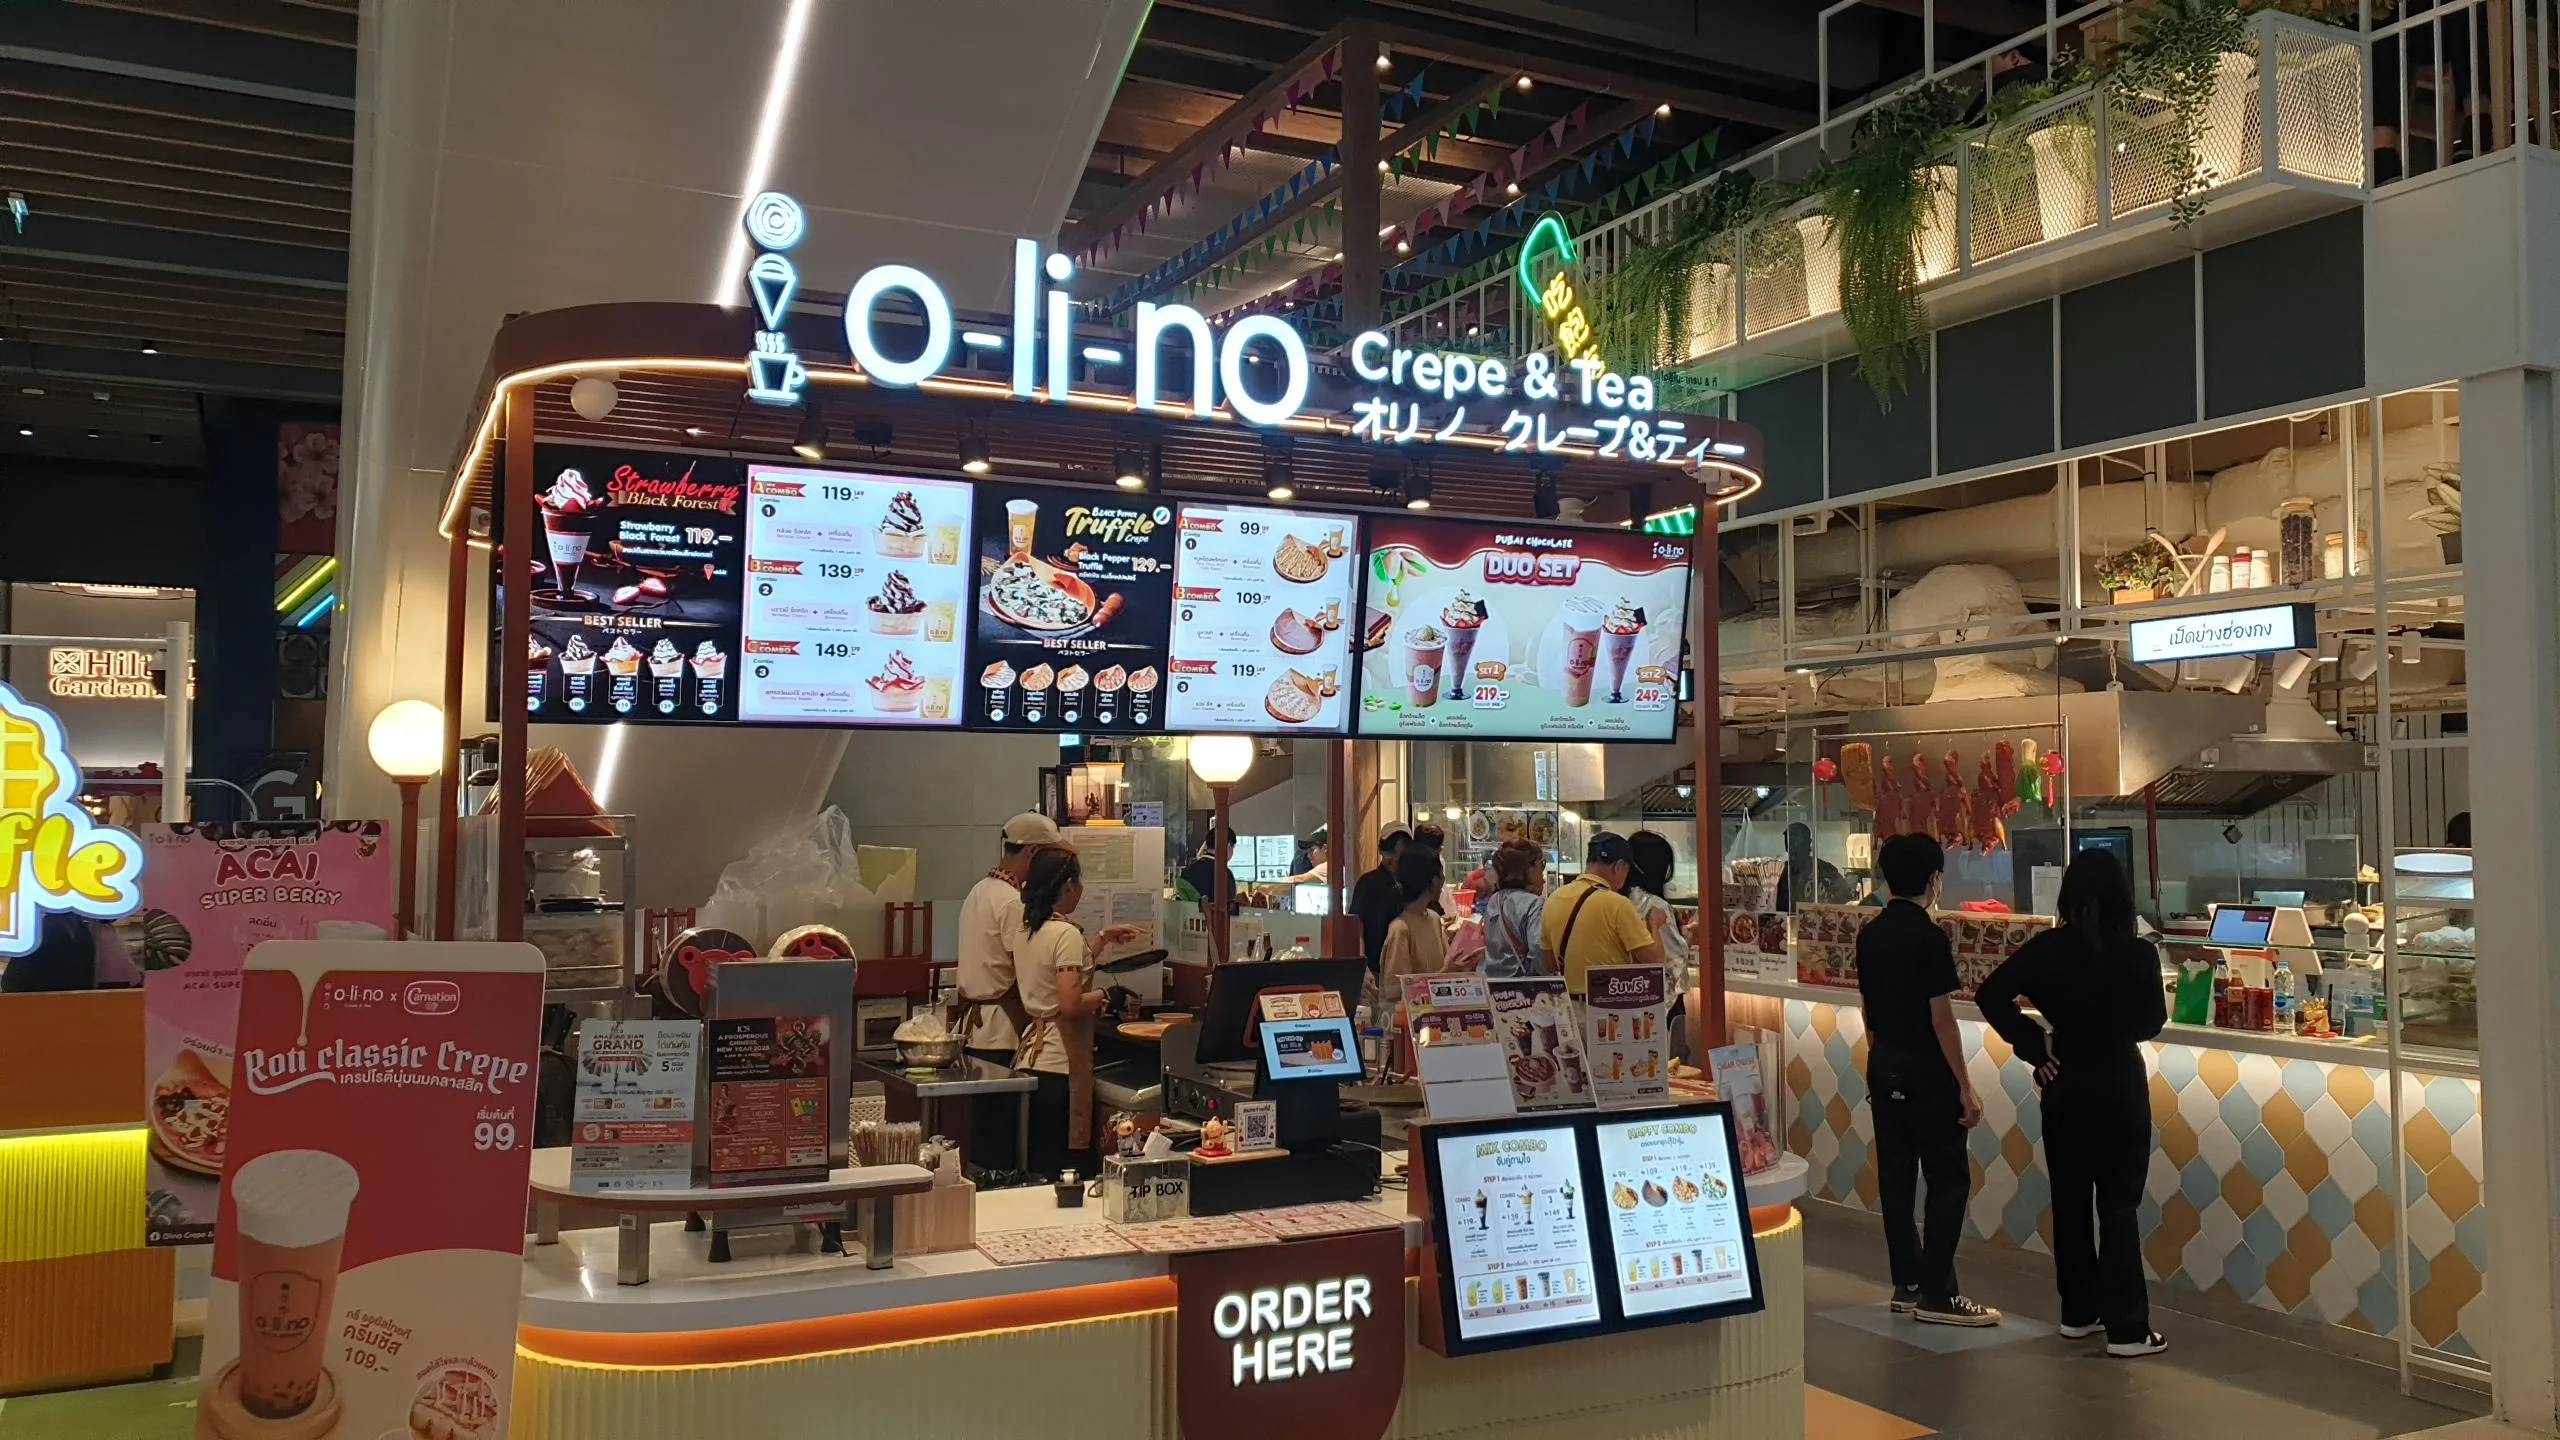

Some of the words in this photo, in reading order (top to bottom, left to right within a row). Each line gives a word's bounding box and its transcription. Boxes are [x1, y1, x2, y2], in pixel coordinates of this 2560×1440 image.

[845, 238, 1309, 425] o-li-no
[1352, 331, 1507, 399] Crepe
[1524, 352, 1558, 399] &
[1571, 359, 1653, 411] Tea
[607, 465, 740, 500] Strawberry
[753, 481, 764, 495] A
[765, 487, 797, 496] COMBO
[626, 491, 667, 508] Black
[672, 493, 719, 510] Forest
[620, 520, 675, 535] Strawberry
[1065, 506, 1155, 543] Truffle
[1178, 518, 1189, 529] A
[1189, 523, 1217, 531] COMBO
[619, 531, 646, 542] Black
[650, 533, 681, 544] Forest
[686, 527, 732, 545] 119.-
[1125, 534, 1149, 545] Crepe
[1495, 534, 1524, 545] DUBAI
[1525, 536, 1573, 548] CHOCOLATE
[1078, 552, 1099, 562] Black
[1102, 553, 1130, 565] Pepper
[1131, 557, 1172, 574] 129.-
[751, 559, 761, 572] B
[762, 565, 795, 574] COMBO
[1078, 562, 1103, 571] Truffle
[1487, 555, 1534, 578] DUO
[1539, 557, 1578, 579] SET
[1175, 587, 1185, 599] B
[584, 615, 614, 627] BEST
[618, 617, 662, 629] SELLER
[2169, 619, 2273, 647] เป็ดย่างฮ่องกง
[759, 646, 792, 654] COMBO
[1042, 639, 1068, 649] BEST
[1070, 640, 1107, 650] SELLER
[1494, 664, 1500, 674] 1
[1641, 671, 1653, 679] SET
[1655, 669, 1661, 679] 2
[50, 675, 148, 698] Garden
[1475, 686, 1507, 701] 219.-
[1636, 688, 1668, 702] 249.-
[215, 848, 320, 887] ACAI
[200, 886, 267, 910] SUPER
[273, 885, 342, 906] BERRY
[213, 981, 241, 989] SUPE
[1454, 988, 1467, 997] 50
[407, 987, 457, 1005] Carnation
[593, 1040, 644, 1050] GRAND
[244, 1045, 310, 1092] Roti
[317, 1038, 427, 1070] classic
[437, 1040, 528, 1095] Crepe
[661, 1060, 670, 1072] 5
[1627, 1124, 1659, 1140] HAPPY
[1661, 1122, 1697, 1135] COMBO
[1476, 1141, 1500, 1158] MIX
[1502, 1139, 1547, 1152] COMBO
[1484, 1175, 1497, 1183] STEP
[1131, 1184, 1151, 1200] TIP
[1156, 1182, 1184, 1197] BOX
[1213, 1277, 1372, 1339] ORDER
[343, 1323, 402, 1356] ครีมชีส
[345, 1347, 389, 1372] 109.-
[1232, 1327, 1355, 1388] HERE
